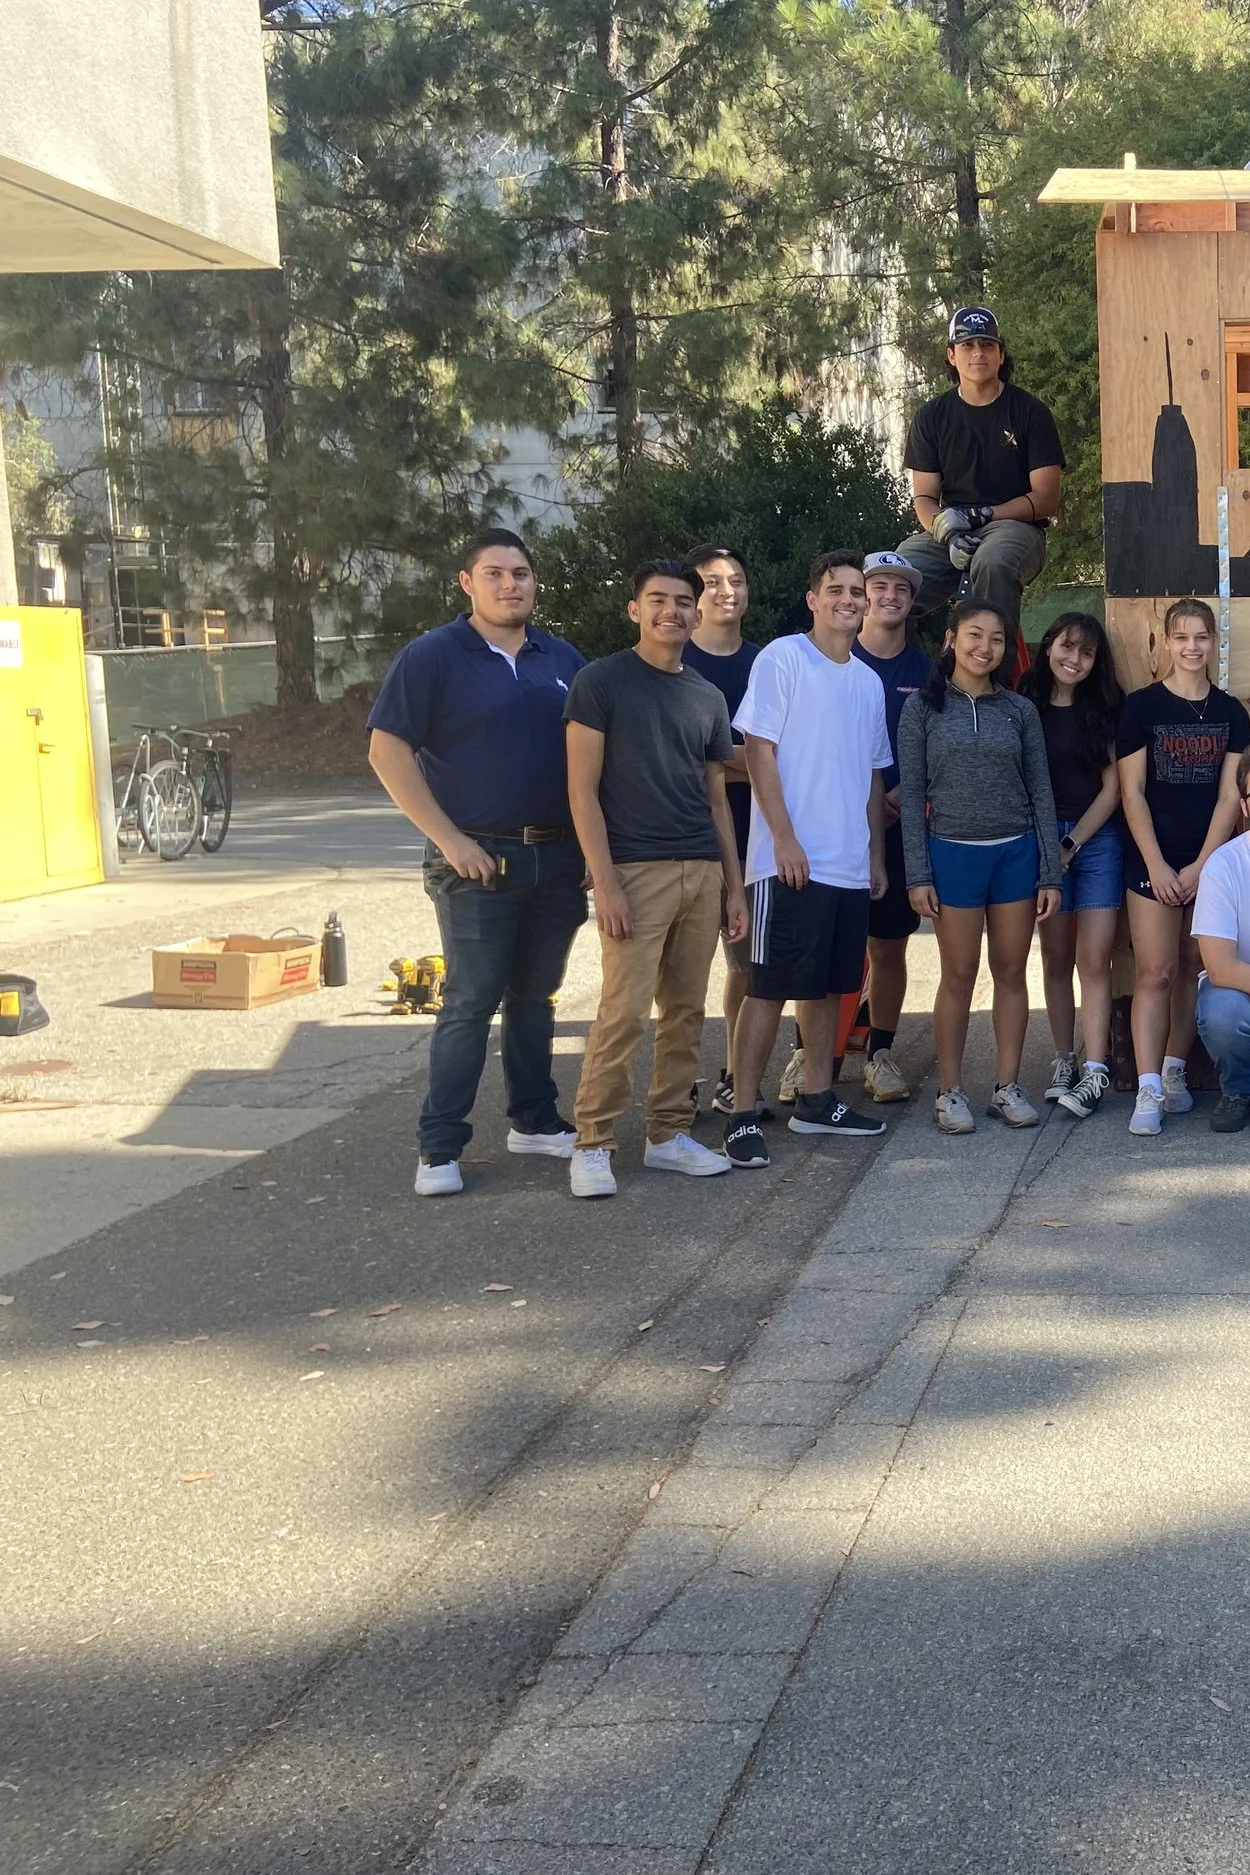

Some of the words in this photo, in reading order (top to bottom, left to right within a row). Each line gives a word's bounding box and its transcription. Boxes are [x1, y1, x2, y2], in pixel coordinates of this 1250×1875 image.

[0, 639, 20, 649] MABLE
[1163, 735, 1228, 753] NOODLE
[727, 1124, 763, 1143] adida
